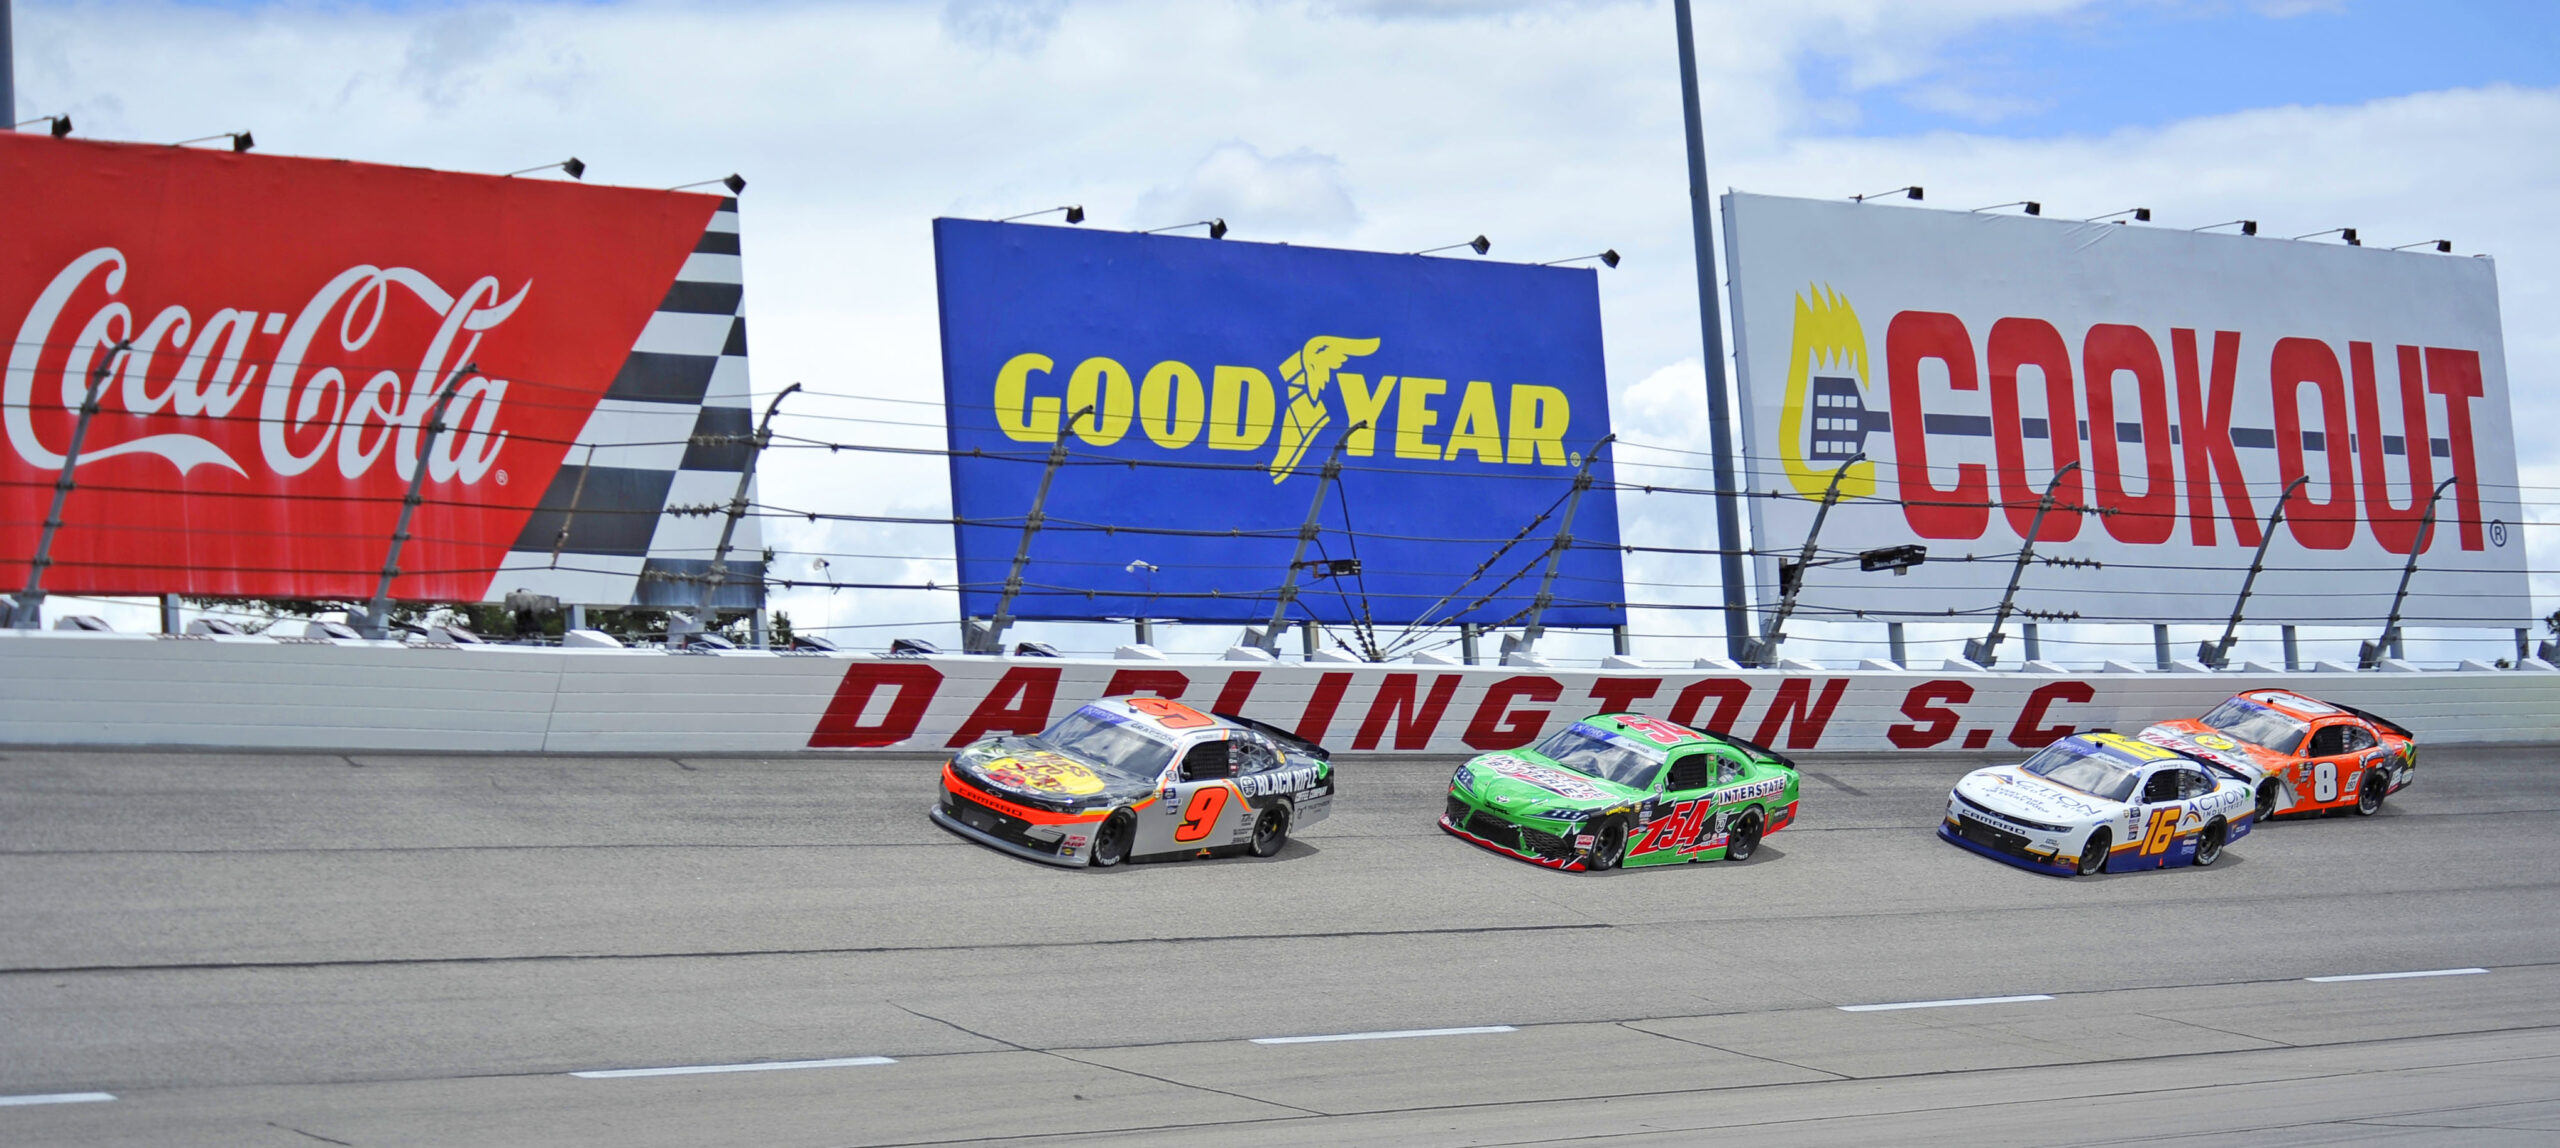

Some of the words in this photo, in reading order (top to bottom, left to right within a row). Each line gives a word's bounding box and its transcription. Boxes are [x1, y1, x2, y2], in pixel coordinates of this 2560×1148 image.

[3, 246, 532, 486] Coca-Cola
[1886, 310, 2263, 547] COOK
[2270, 337, 2484, 555] OUT
[1886, 679, 2112, 750] S.C
[958, 787, 1023, 817] CAMARO
[1254, 771, 1293, 796] BLACK
[1293, 767, 1318, 792] RIFLE
[1719, 778, 1785, 804] INTERSTATE
[2189, 788, 2246, 812] ACTION
[2314, 762, 2338, 803] 8
[1174, 786, 1229, 844] 9
[1658, 798, 1711, 851] 54
[1961, 808, 2027, 836] CAMARO
[2139, 805, 2182, 857] 16
